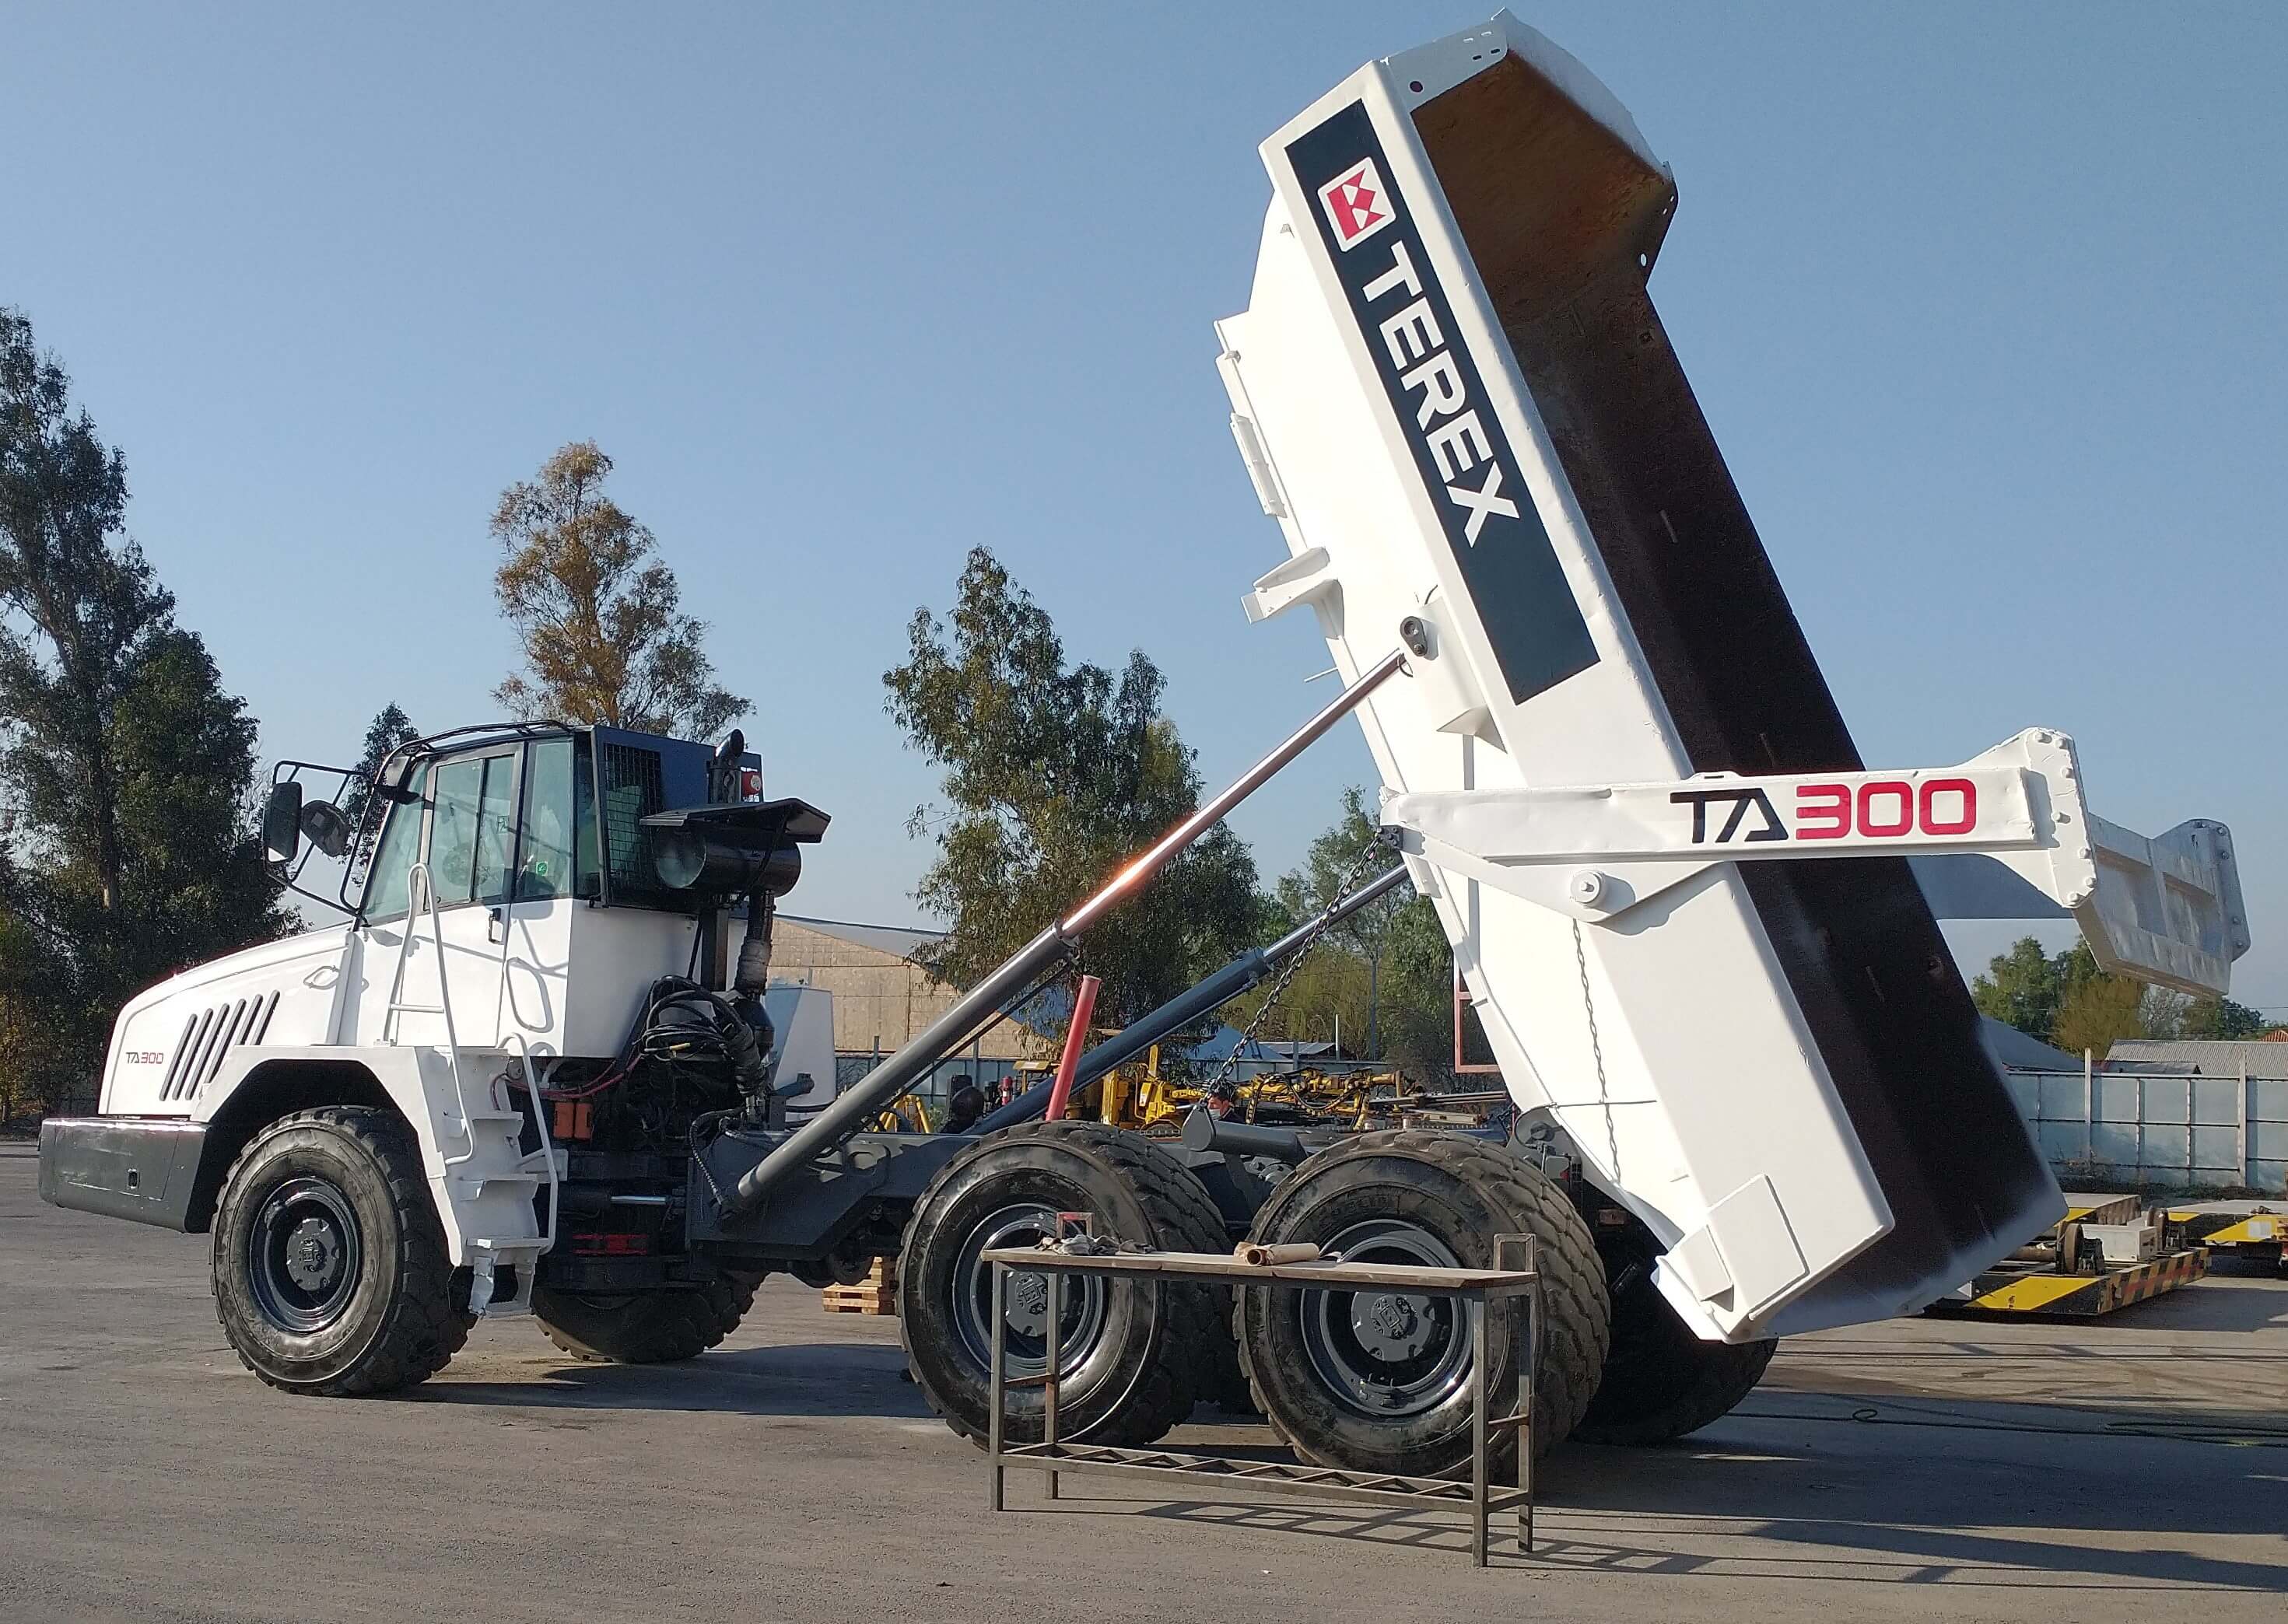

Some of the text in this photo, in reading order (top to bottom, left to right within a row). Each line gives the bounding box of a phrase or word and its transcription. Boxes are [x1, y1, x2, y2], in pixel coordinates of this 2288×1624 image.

[1362, 240, 1519, 548] TEREX
[1670, 779, 1976, 842] TA300
[125, 1052, 164, 1065] TA300
